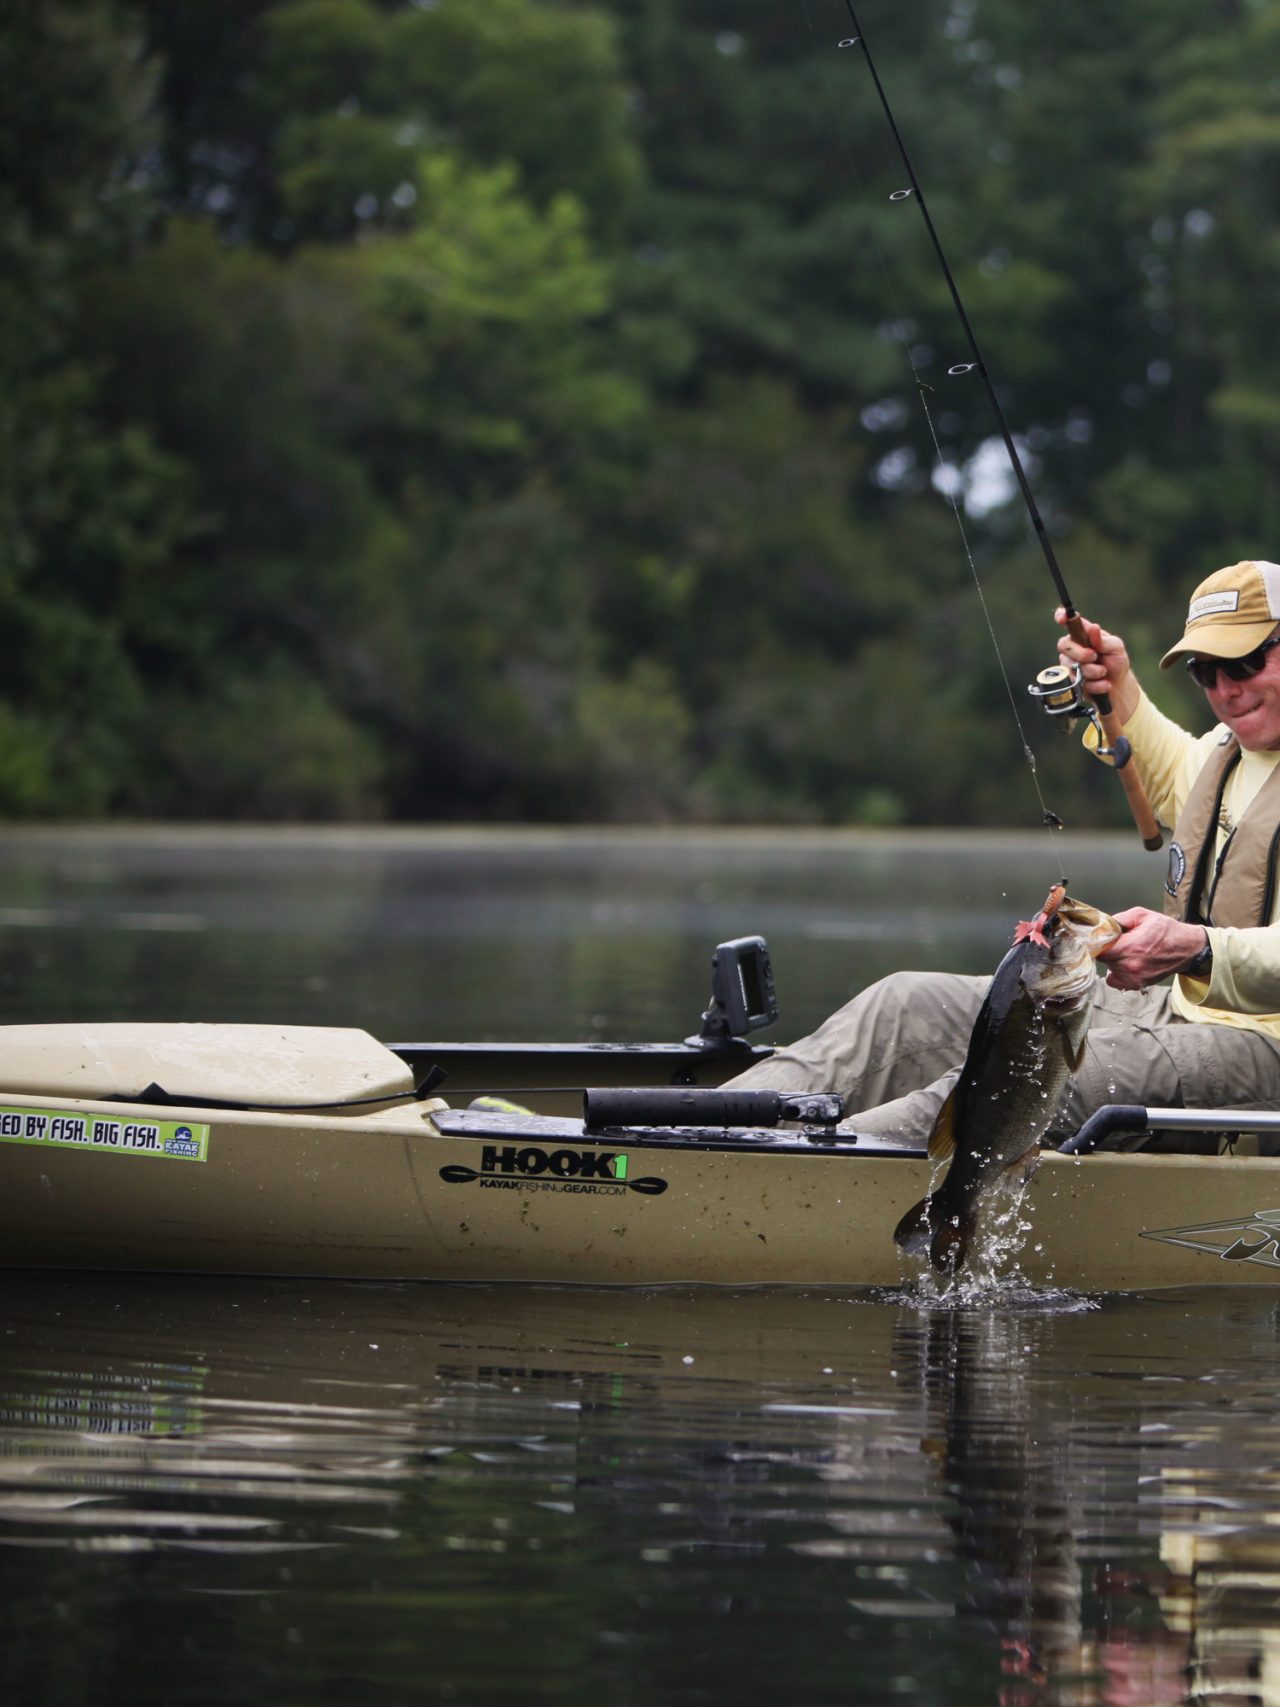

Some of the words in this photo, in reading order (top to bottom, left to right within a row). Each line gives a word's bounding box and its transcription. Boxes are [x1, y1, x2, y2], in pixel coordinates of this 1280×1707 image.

[0, 1114, 21, 1136] ED
[26, 1116, 47, 1138] BY
[51, 1118, 88, 1141] FISH.
[93, 1121, 119, 1145] BIG
[123, 1125, 161, 1149] FISH.
[165, 1141, 199, 1151] KAYAK
[481, 1145, 629, 1179] HOOK1
[480, 1179, 626, 1196] KAYAKFISHINGGEAR.COM
